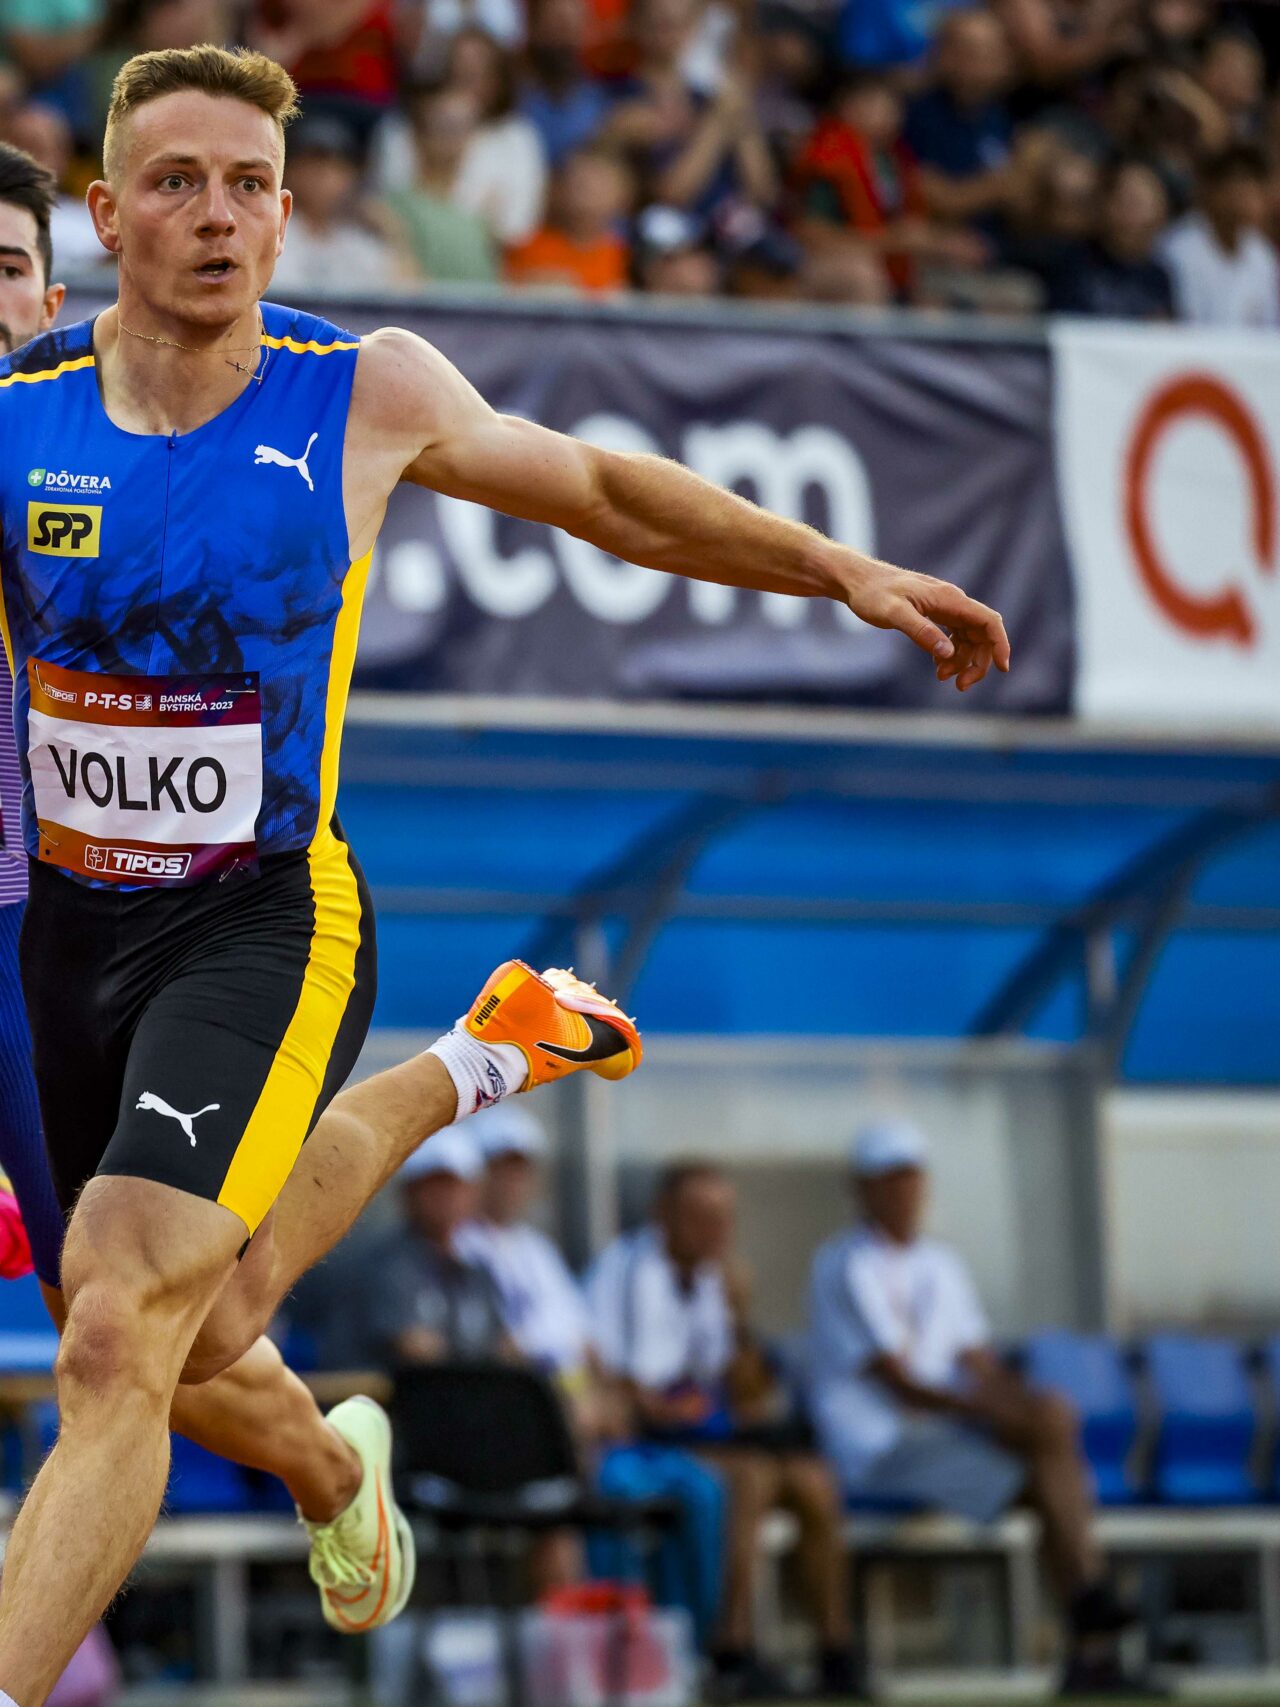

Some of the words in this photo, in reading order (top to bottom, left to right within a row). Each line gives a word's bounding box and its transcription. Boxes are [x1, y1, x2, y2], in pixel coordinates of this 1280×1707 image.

[33, 511, 93, 549] SPP
[51, 689, 75, 701] TIPOS
[84, 692, 133, 710] P-T-S
[160, 692, 202, 704] BANSKÁ
[159, 703, 208, 712] BYSTRICA
[210, 701, 234, 711] 2023
[47, 744, 227, 813] VOLKO
[113, 851, 184, 874] TIPOS
[474, 994, 501, 1026] PUMA
